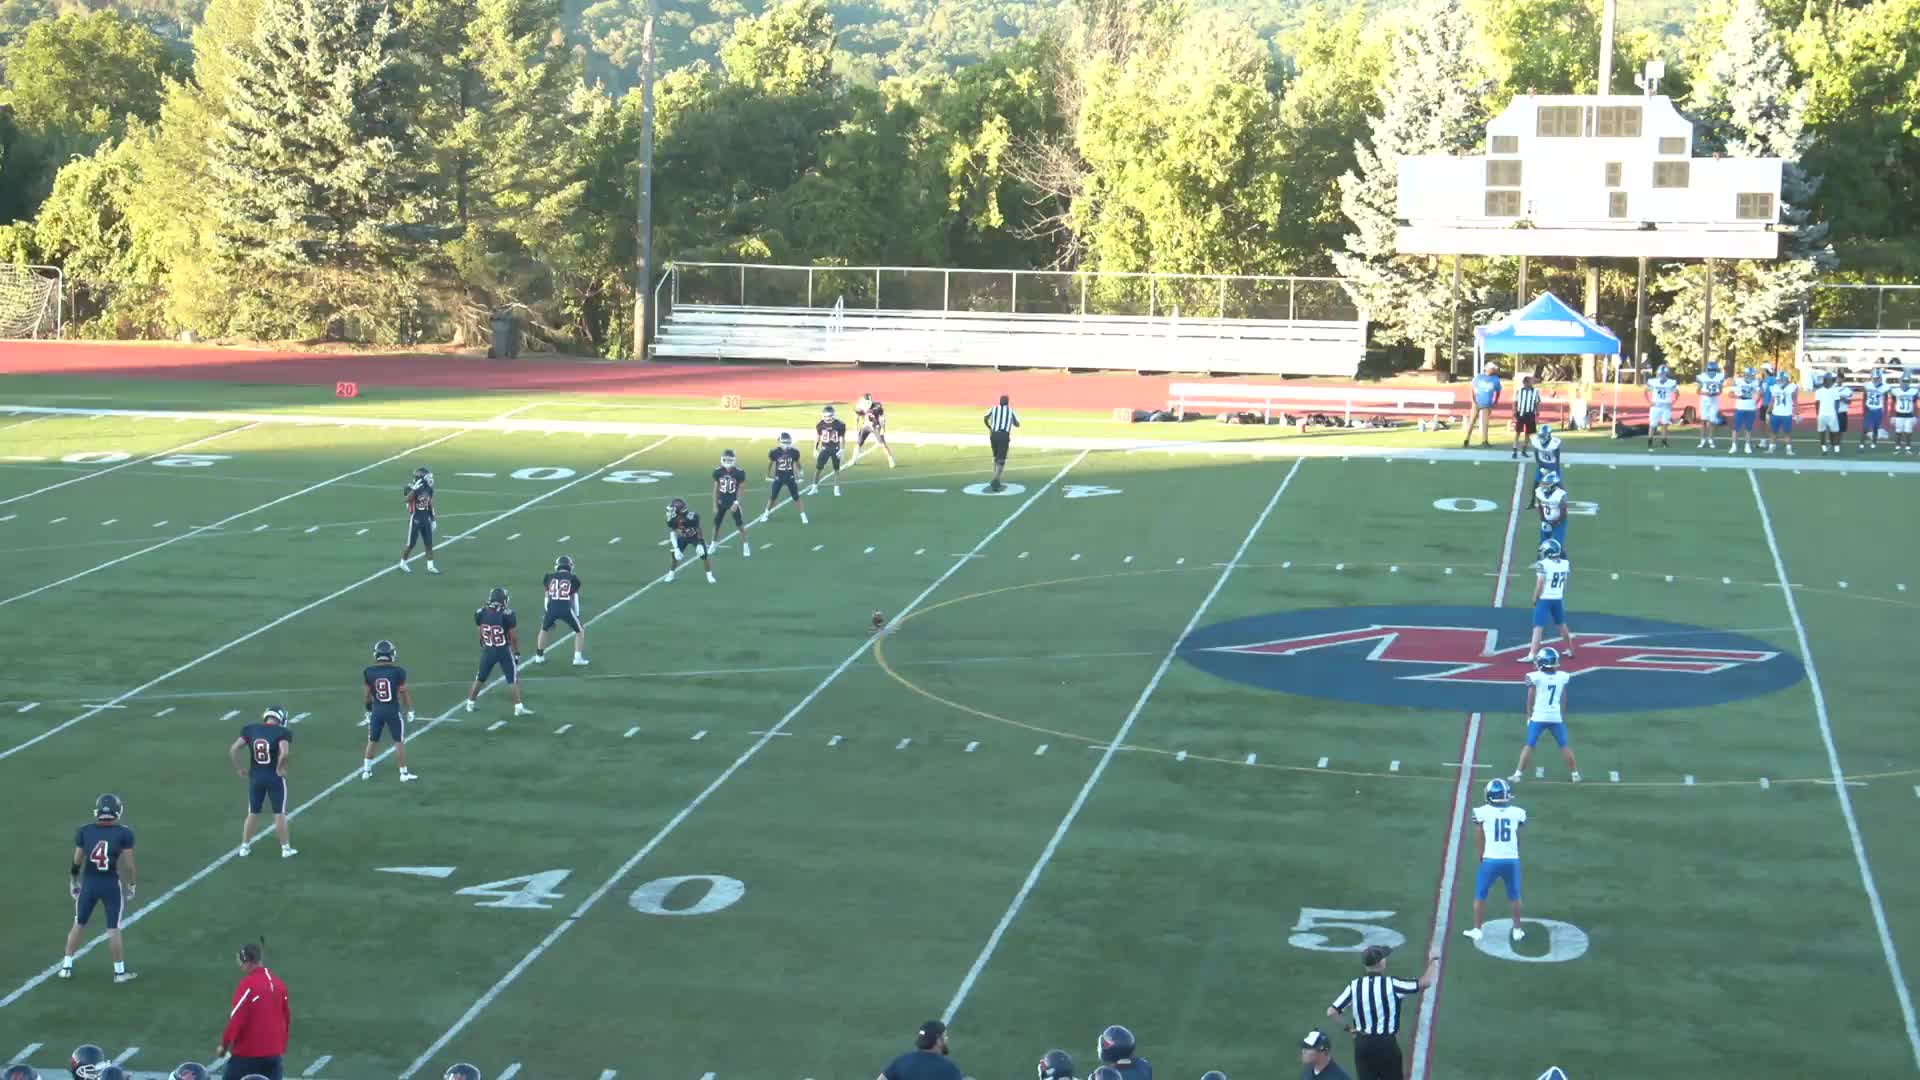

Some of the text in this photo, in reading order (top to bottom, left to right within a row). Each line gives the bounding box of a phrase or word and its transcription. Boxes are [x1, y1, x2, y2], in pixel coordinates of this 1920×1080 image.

[549, 578, 572, 601] 42
[375, 677, 393, 702] 9
[1547, 684, 1557, 706] 7
[253, 738, 271, 764] 8
[1493, 817, 1511, 843] 16
[90, 840, 109, 871] 4
